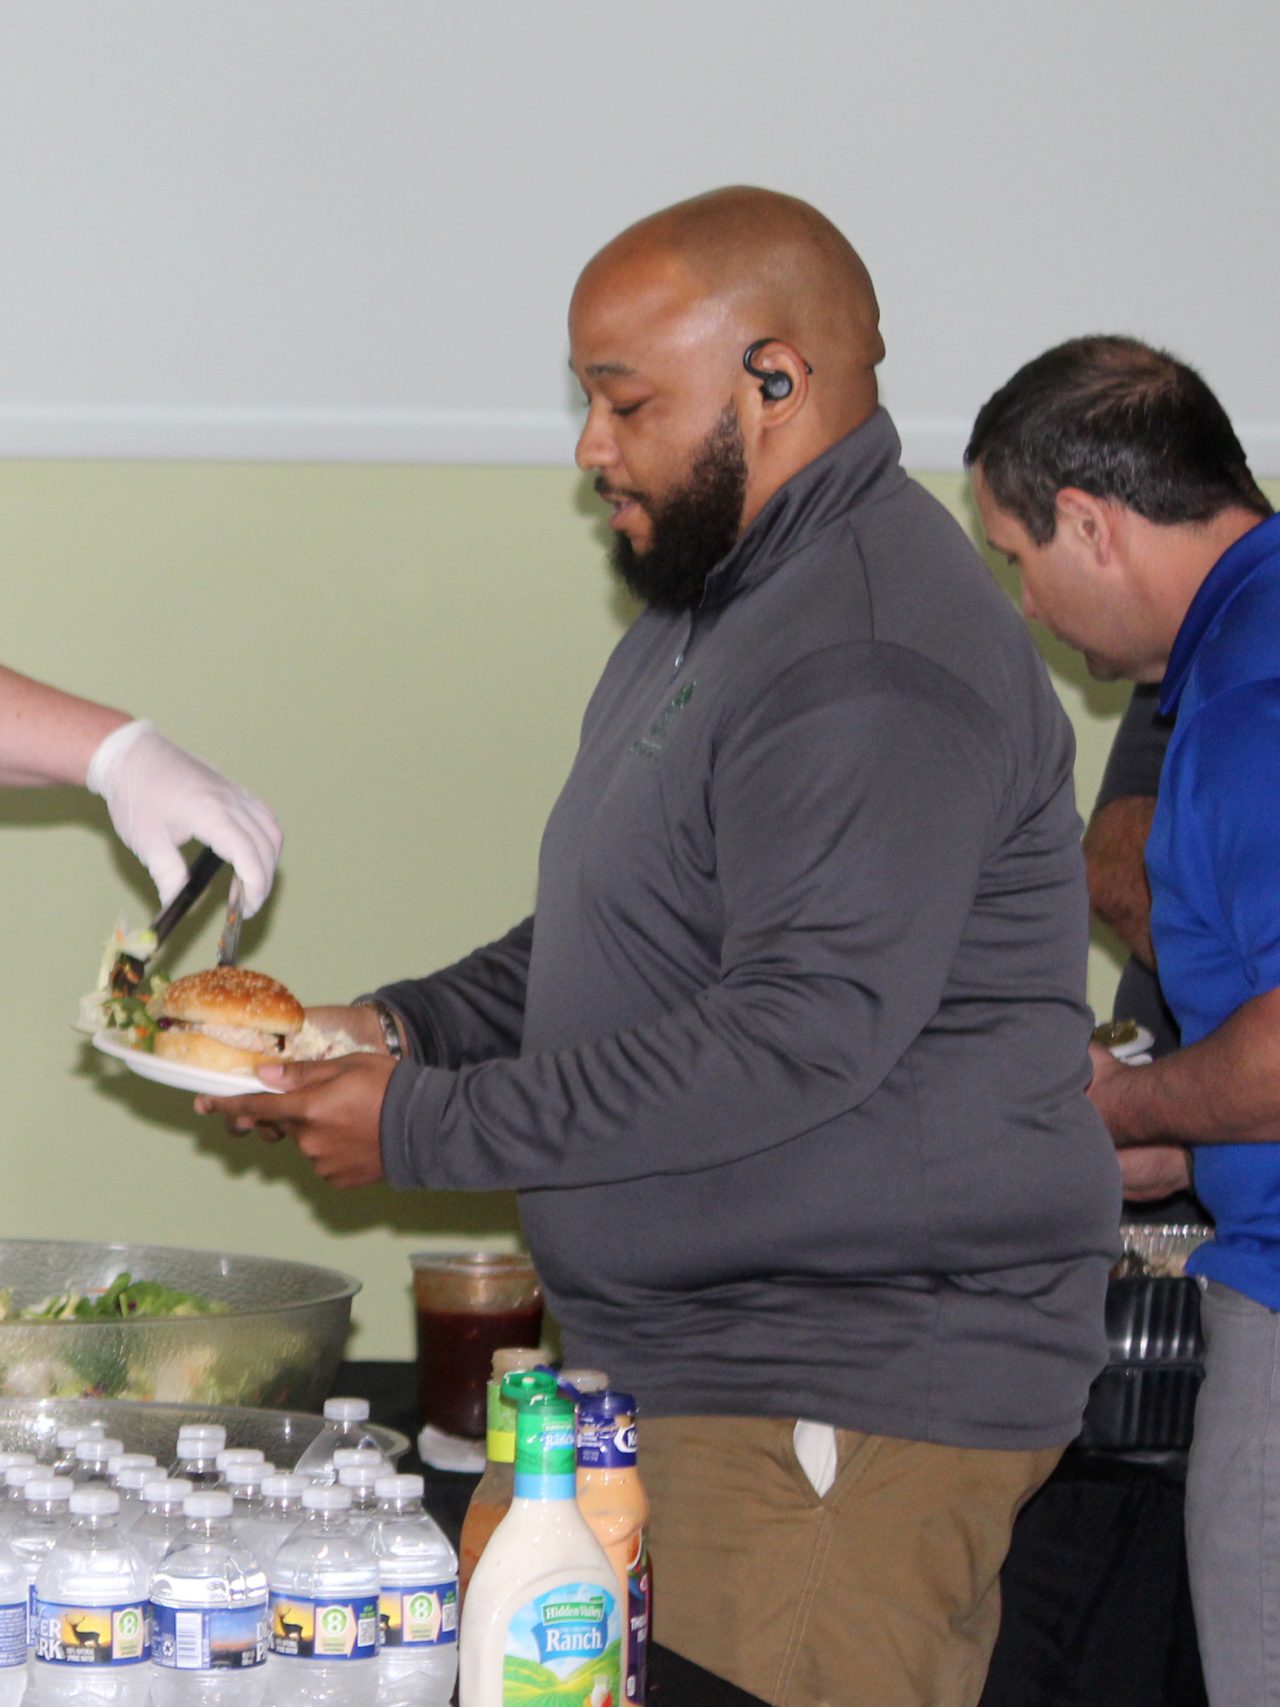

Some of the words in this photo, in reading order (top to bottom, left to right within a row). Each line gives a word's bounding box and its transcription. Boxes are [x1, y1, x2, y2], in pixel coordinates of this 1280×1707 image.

[545, 1604, 579, 1619] Hidden
[579, 1604, 601, 1620] Valley
[545, 1626, 603, 1652] Ranch
